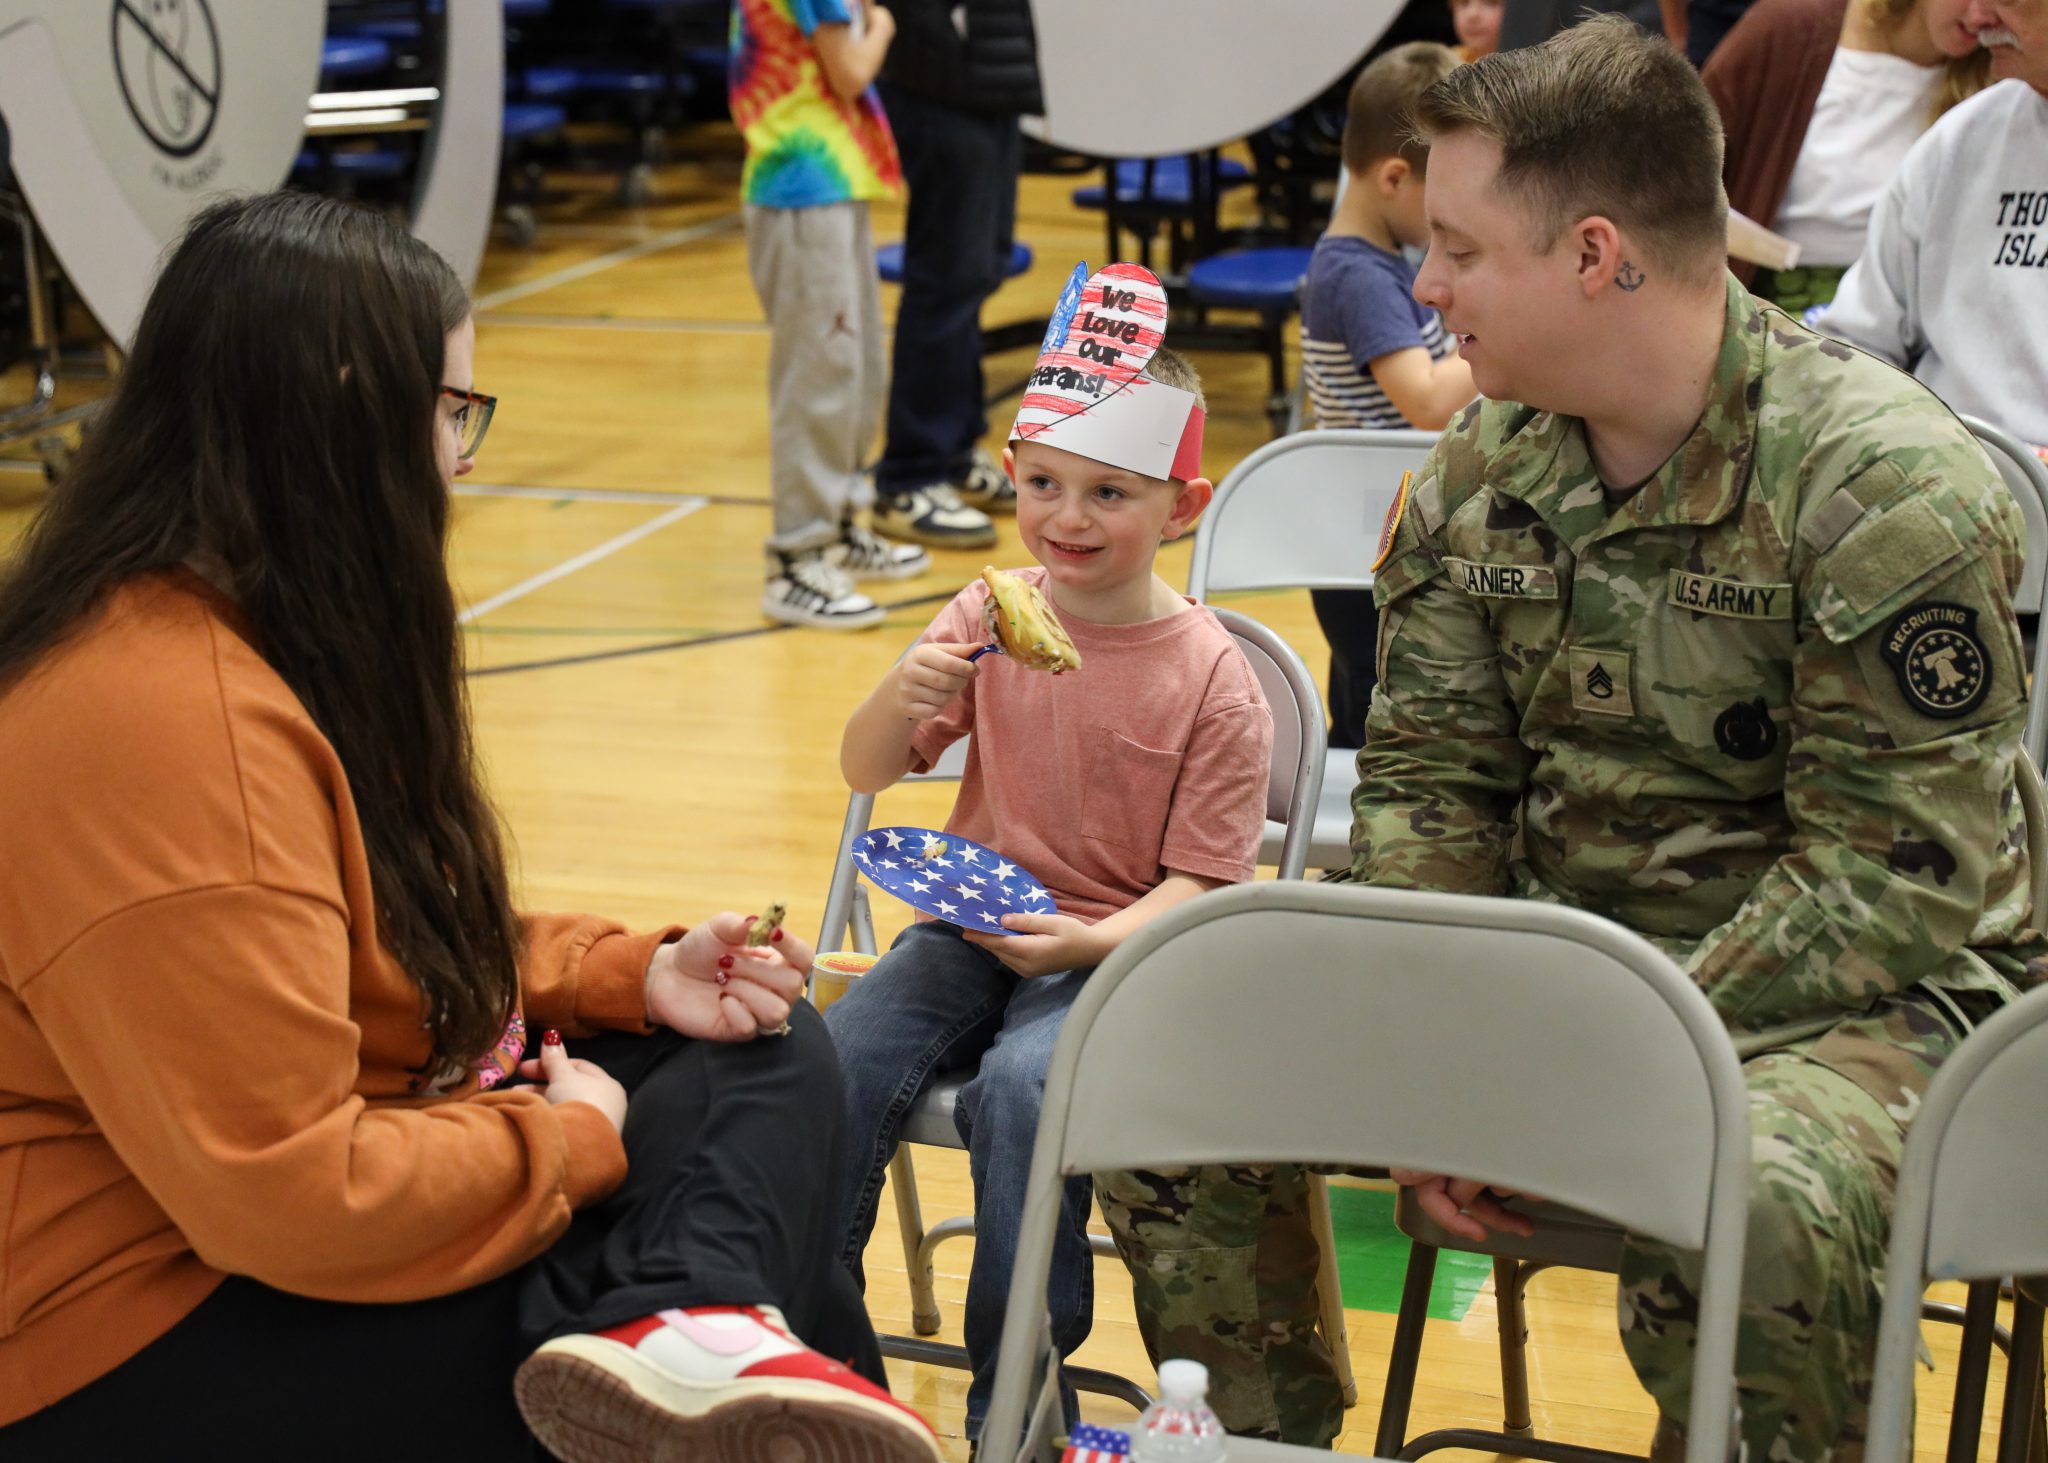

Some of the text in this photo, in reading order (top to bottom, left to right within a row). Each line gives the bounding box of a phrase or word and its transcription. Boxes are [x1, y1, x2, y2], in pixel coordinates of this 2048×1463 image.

[1102, 285, 1136, 313] We
[1081, 312, 1139, 344] Love
[1078, 338, 1122, 367] Our
[1889, 608, 1967, 653] RECRUITING
